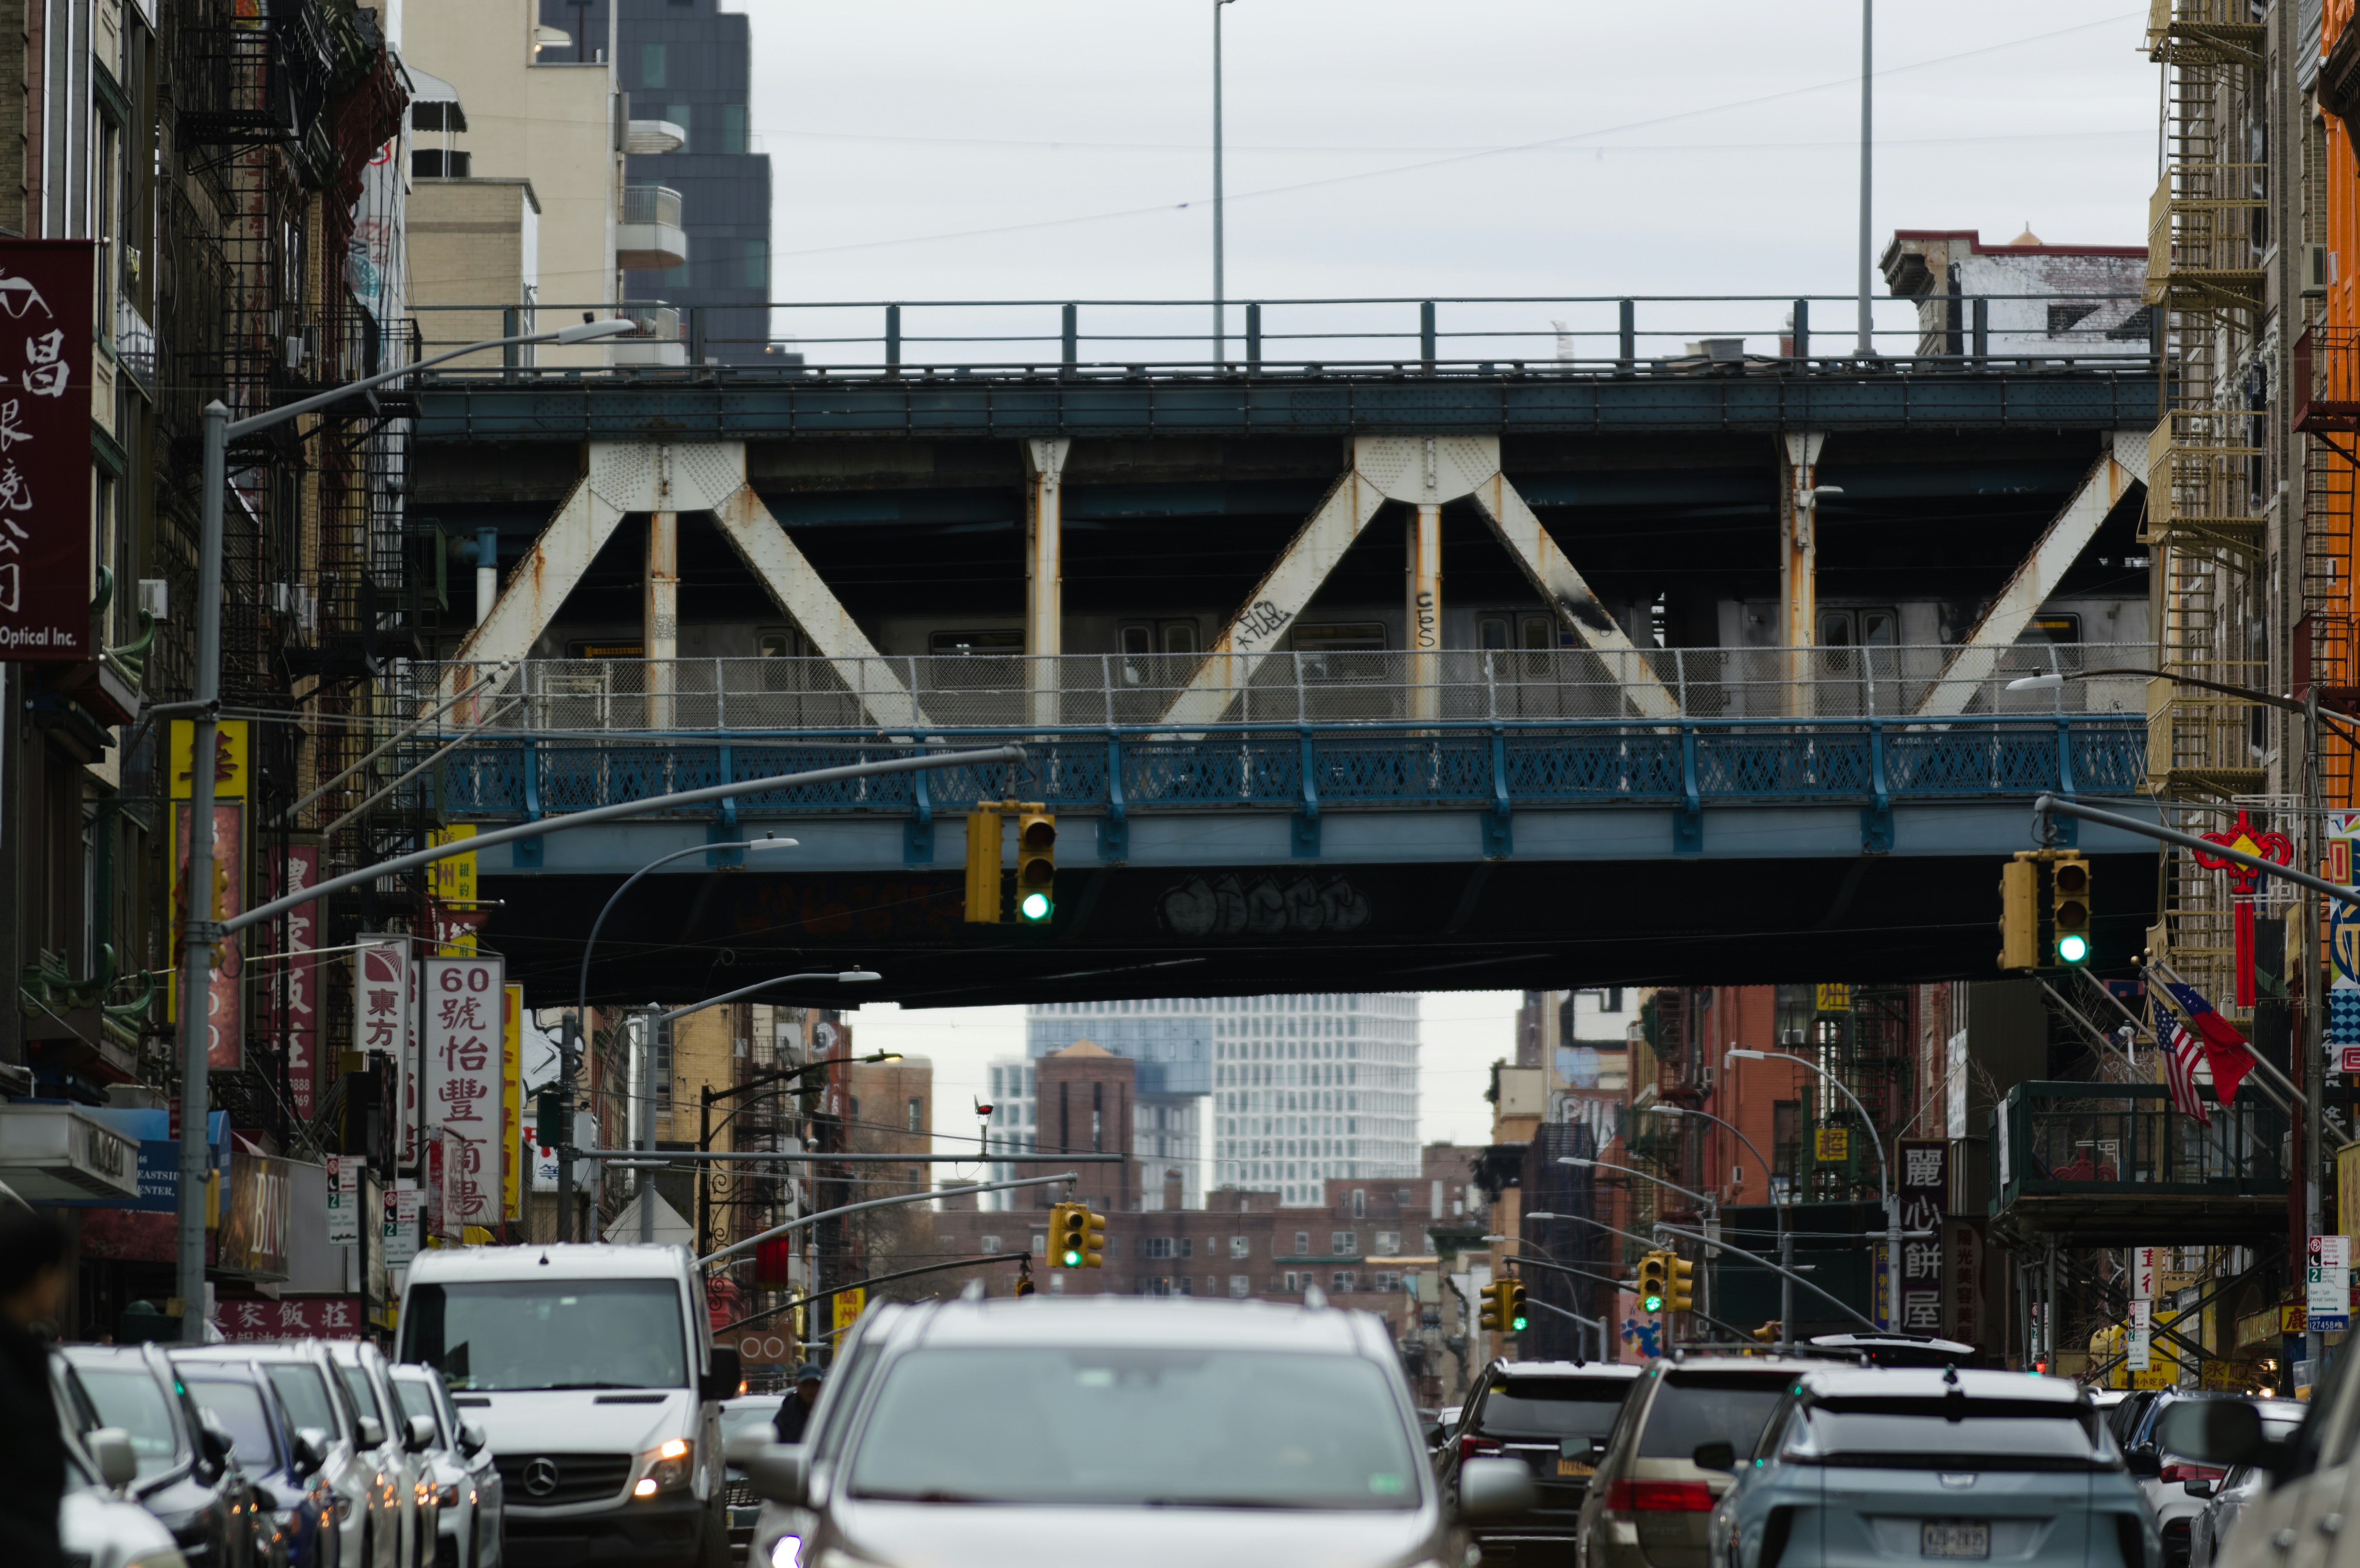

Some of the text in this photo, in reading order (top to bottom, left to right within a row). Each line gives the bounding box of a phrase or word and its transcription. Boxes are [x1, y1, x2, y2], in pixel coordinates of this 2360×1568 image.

[0, 626, 77, 649] Optical Inc.
[366, 988, 398, 1046] 東方
[331, 1194, 337, 1207] 2
[387, 1224, 394, 1236] 2
[1903, 1149, 1943, 1329] 麗心餅屋
[2311, 1269, 2318, 1282] 2
[2309, 1321, 2334, 1330] 127458
[2130, 1331, 2134, 1341] 2
[2205, 1361, 2248, 1380] 永順
